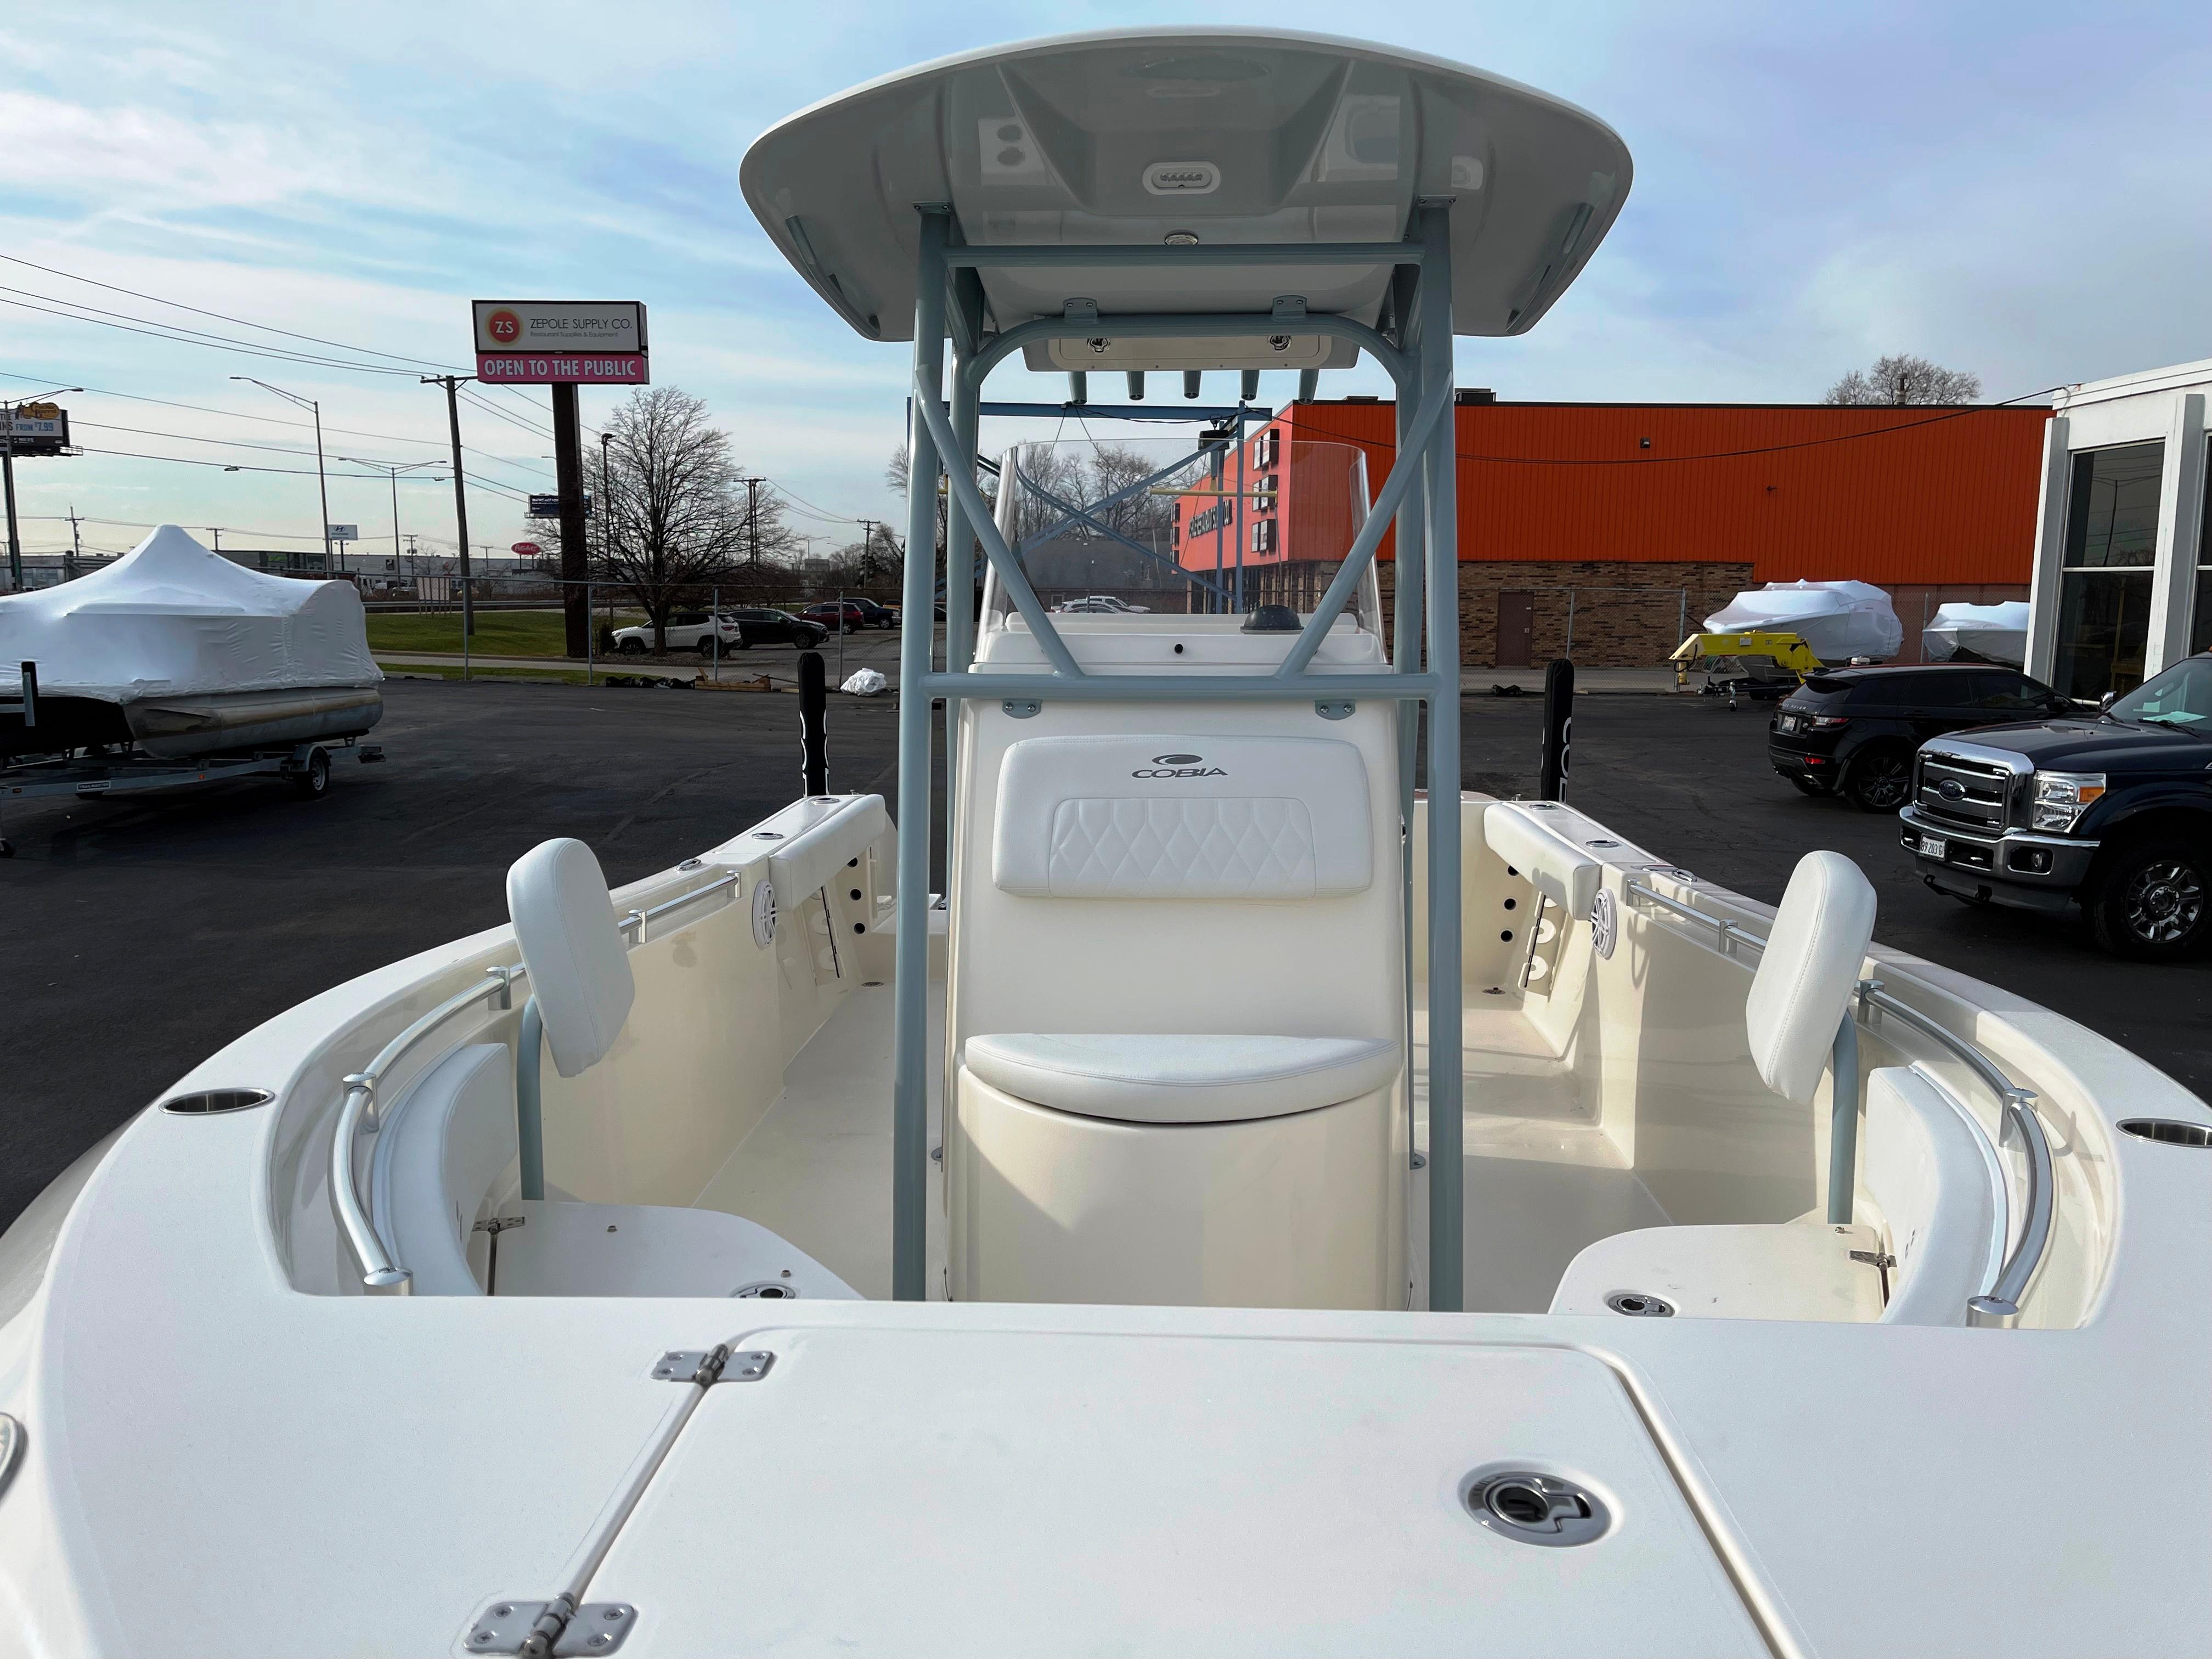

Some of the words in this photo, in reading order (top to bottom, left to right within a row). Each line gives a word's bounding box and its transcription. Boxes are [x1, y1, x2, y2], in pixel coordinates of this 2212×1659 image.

[495, 321, 514, 334] ZS
[531, 319, 568, 329] ZEPOLE
[573, 319, 609, 329] SUPPLY
[611, 319, 633, 329] CO.
[484, 360, 524, 376] OPEN
[528, 360, 548, 376] TO
[552, 360, 579, 376] THE
[584, 360, 636, 376] PUBLIC
[1132, 768, 1228, 778] COBIA
